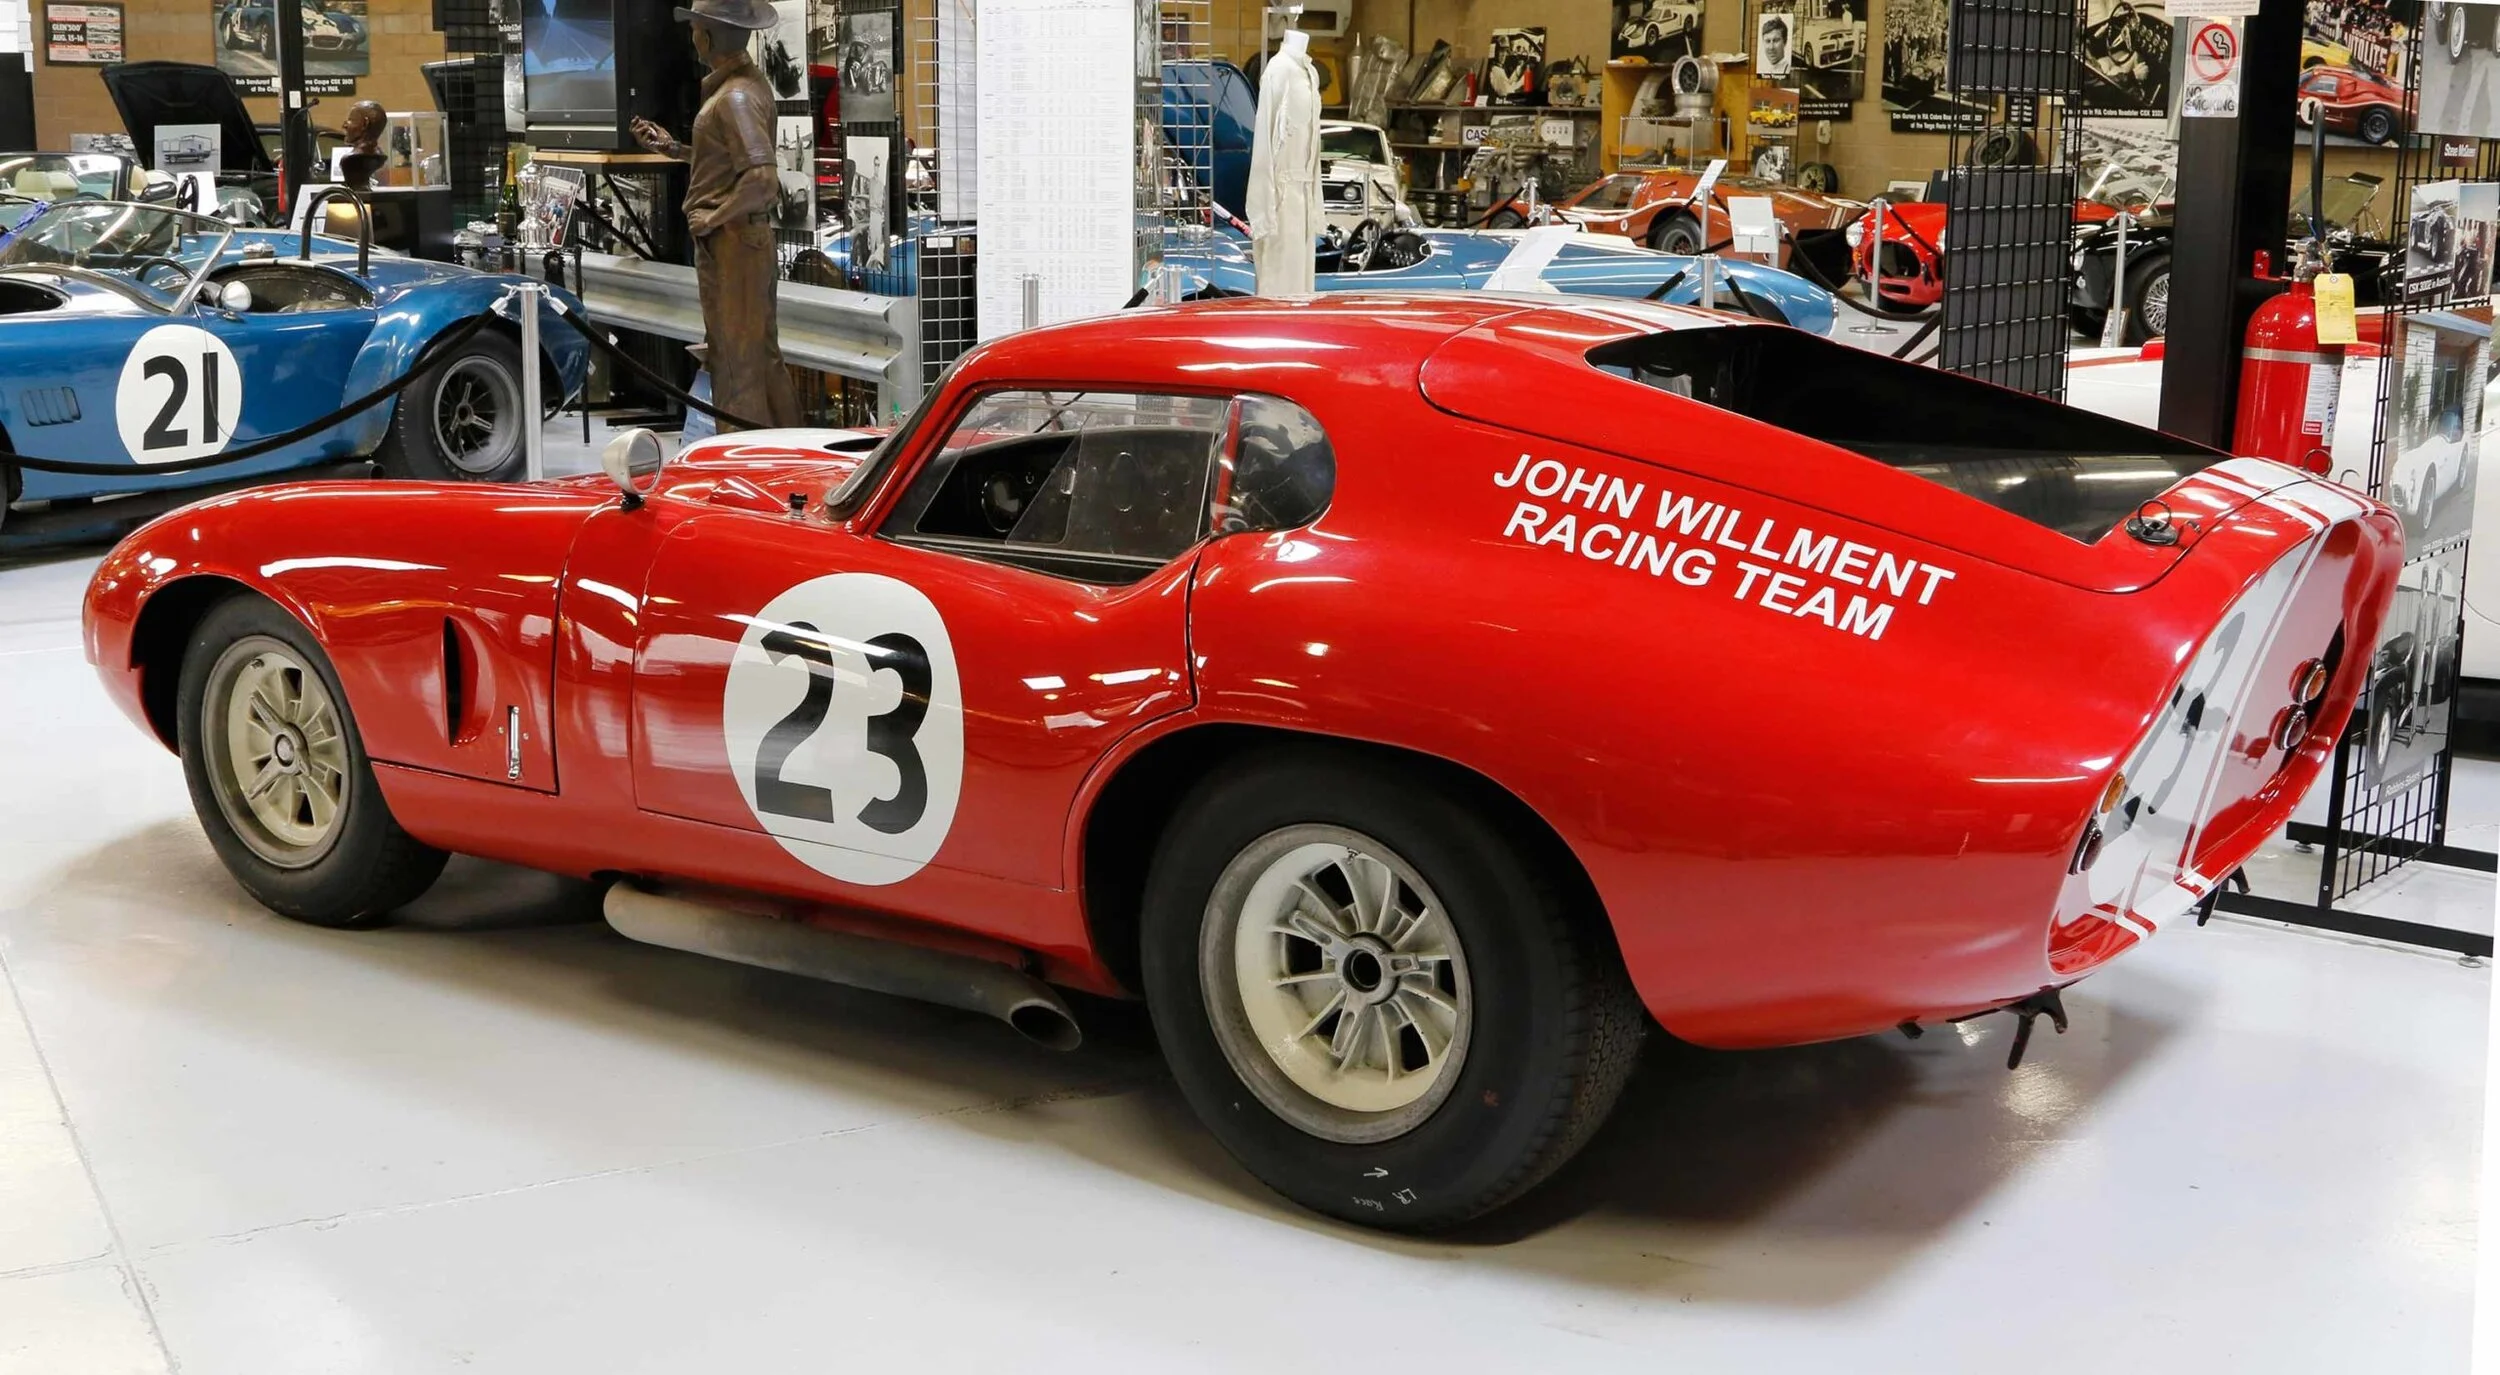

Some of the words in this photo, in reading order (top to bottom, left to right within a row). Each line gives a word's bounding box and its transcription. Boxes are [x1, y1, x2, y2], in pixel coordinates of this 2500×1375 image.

[143, 352, 218, 451] 21
[1494, 453, 1645, 518] JOHN
[1655, 490, 1956, 605] WILLMENT
[1503, 502, 1717, 586] RACING
[1733, 561, 1894, 640] TEAM
[755, 621, 932, 834] 23
